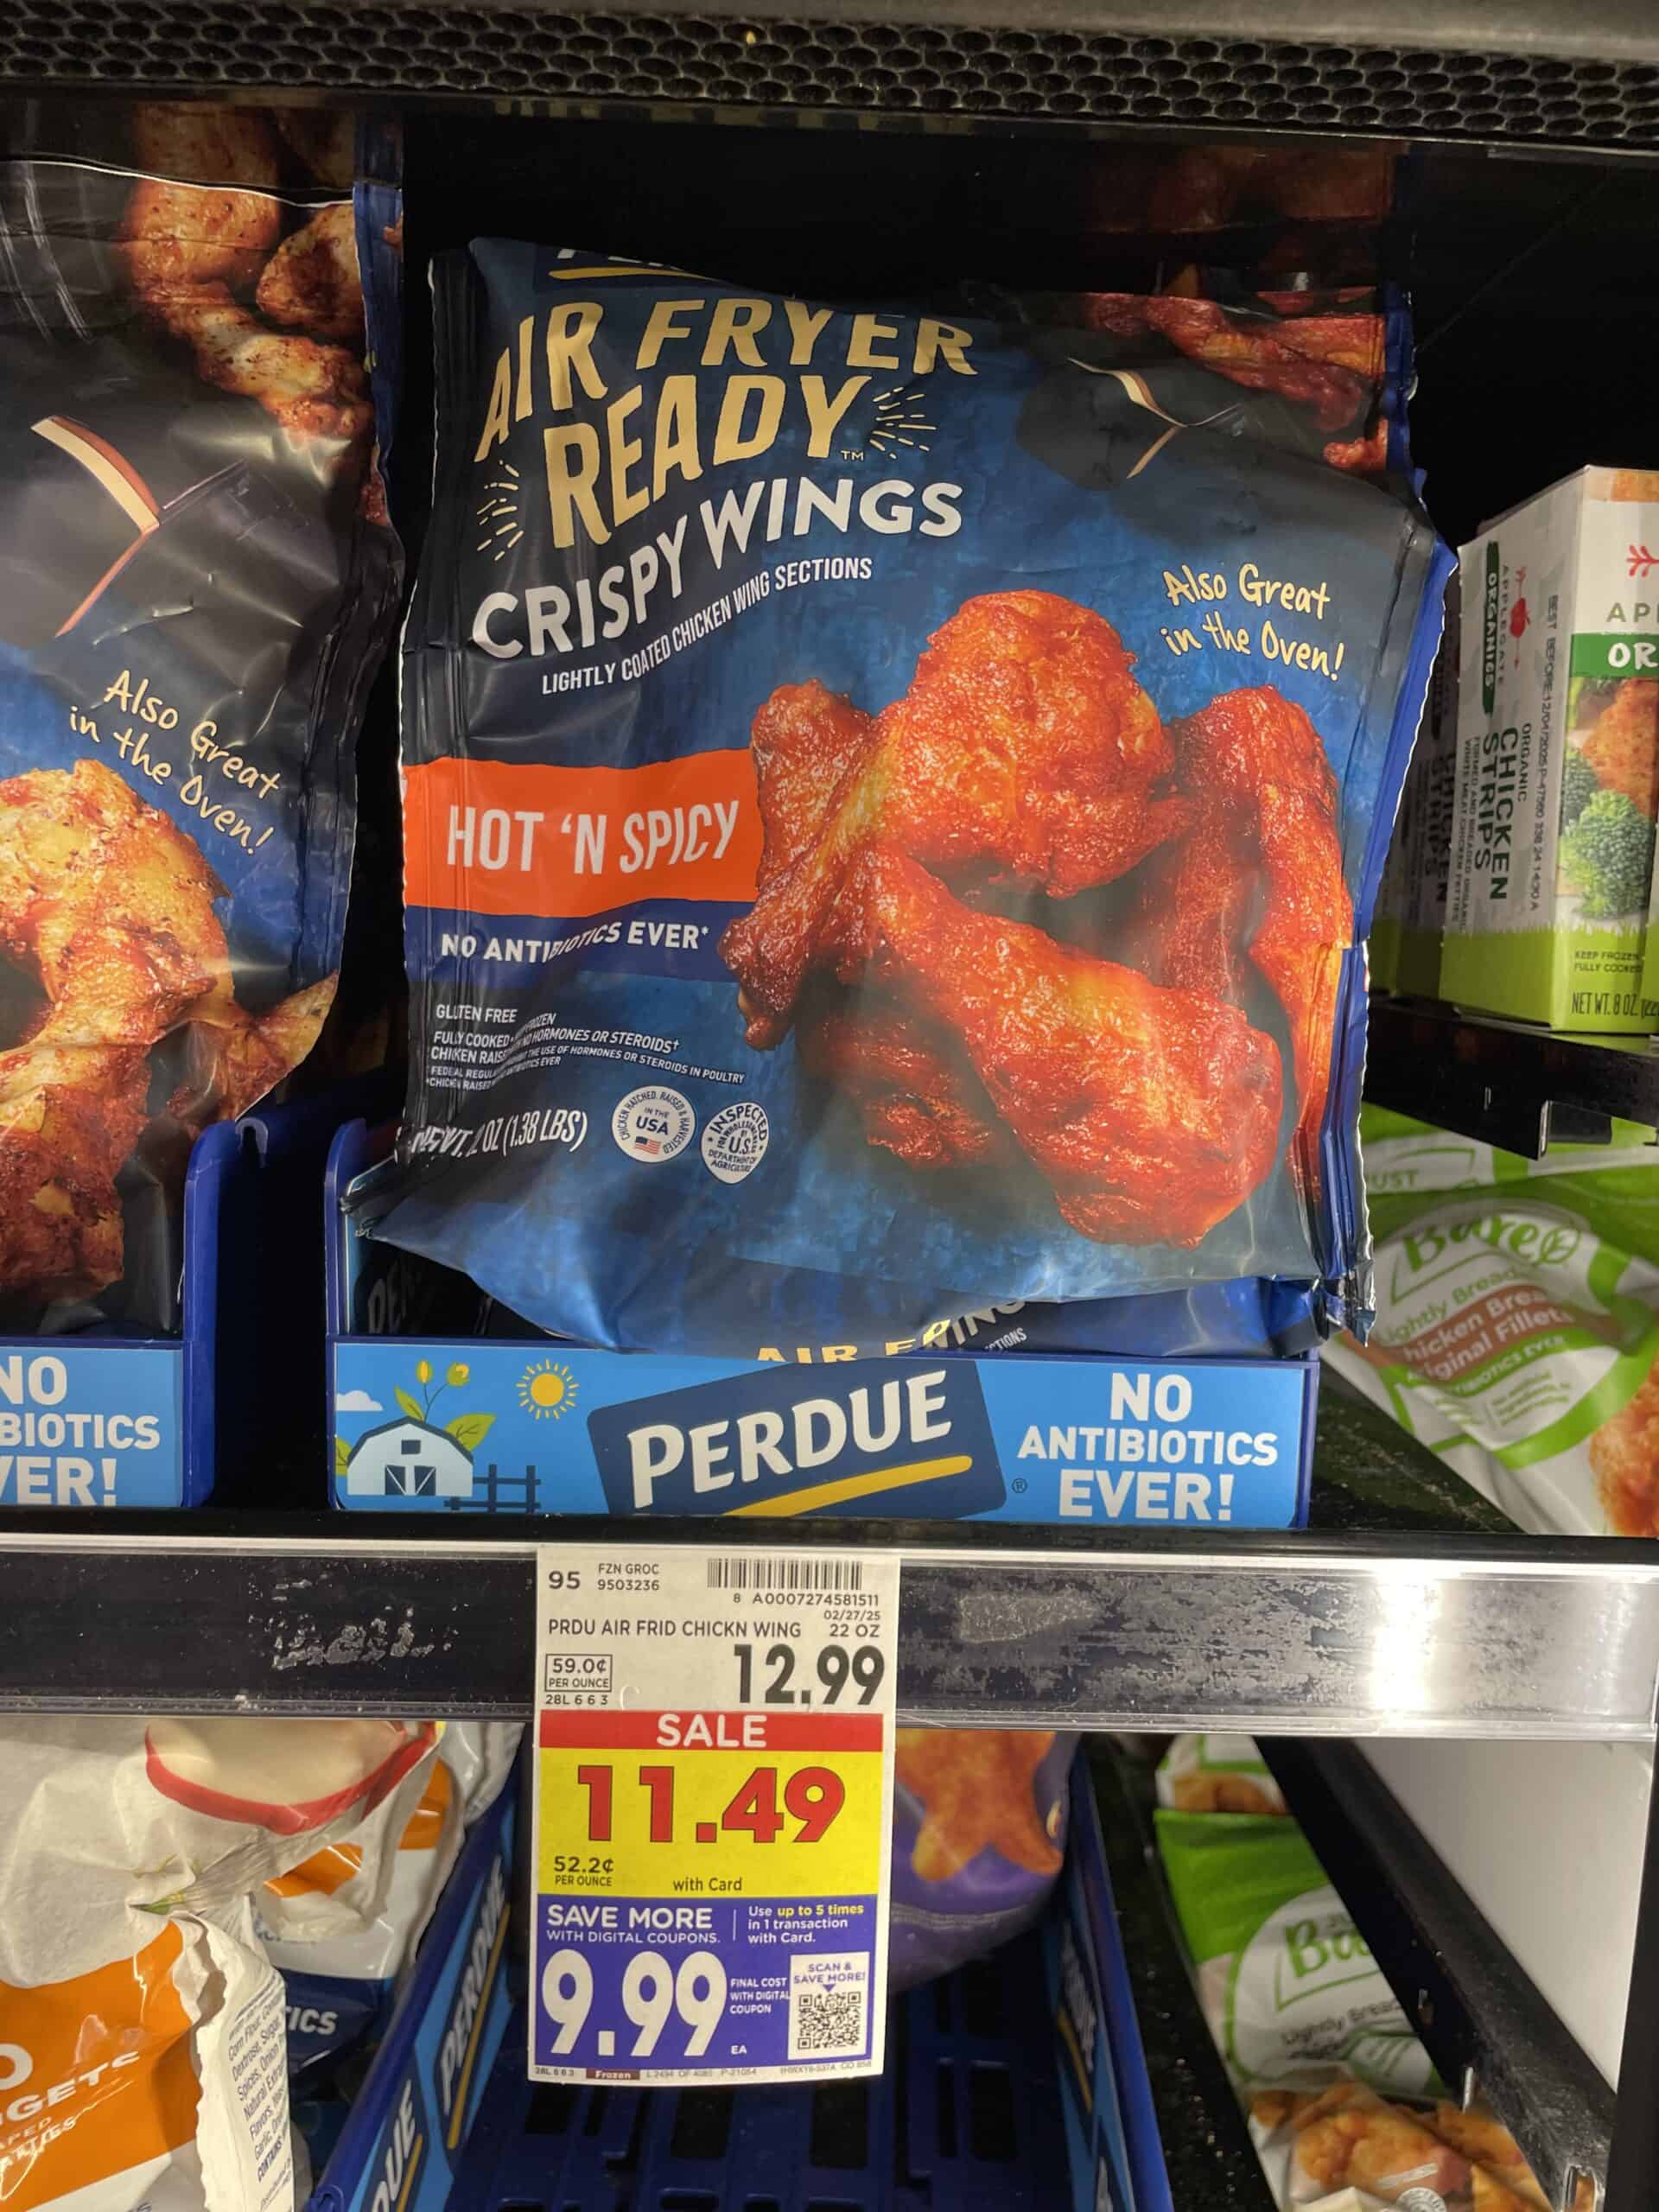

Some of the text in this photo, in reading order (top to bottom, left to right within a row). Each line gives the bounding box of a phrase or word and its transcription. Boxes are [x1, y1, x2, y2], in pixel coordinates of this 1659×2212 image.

[474, 298, 979, 463] AIR FRYER
[543, 374, 872, 550] READY
[472, 478, 963, 659] CRISPY WINGS
[1162, 563, 1332, 620] Also Great
[1605, 601, 1659, 623] AP
[542, 557, 873, 696] LIGHTLY COATED CHICKEN WING SECTIONS
[1485, 572, 1498, 688] ORGANICS
[1160, 610, 1345, 682] in the Oven!
[103, 669, 281, 799] Also Great
[1516, 722, 1532, 803] ORGANIC
[69, 705, 274, 855] in the Oven!
[1475, 734, 1498, 870] STRIPS
[1490, 728, 1518, 899] CHICKEN
[447, 804, 543, 872] HOT
[619, 799, 740, 874] SPICY
[441, 933, 476, 958] NO
[482, 920, 622, 964] ANTIBIOTICS
[1572, 992, 1592, 1015] NET
[485, 1008, 518, 1023] FREE
[532, 1028, 590, 1043] HORMONES
[592, 1030, 607, 1042] OR
[540, 1056, 562, 1066] EVER
[541, 1046, 556, 1055] USE
[557, 1046, 568, 1054] OF
[570, 1046, 622, 1059] HORMONES
[624, 1052, 637, 1062] OR
[639, 1055, 689, 1074] STEROIDS
[690, 1066, 700, 1077] IN
[702, 1068, 746, 1084] POULTRY
[617, 1109, 631, 1141] CHICKEN
[660, 1091, 684, 1111] RAISED
[655, 1109, 670, 1118] THE
[709, 1105, 768, 1141] INSPECTED
[482, 1118, 505, 1153] OZ
[502, 1110, 541, 1157] (1.38
[539, 1109, 588, 1153] LBS)
[636, 1116, 669, 1135] USA
[1402, 1312, 1484, 1363] hicken
[1109, 1372, 1192, 1423] NO
[626, 1369, 952, 1510] PERDUE
[1017, 1426, 1279, 1467] ANTIBIOTICS
[1058, 1469, 1234, 1522] EVER!
[598, 1562, 659, 1575] FZN GROC
[548, 1571, 582, 1590] 95
[597, 1579, 660, 1592] 9503236
[733, 1593, 880, 1607] 8 A0007274581511
[823, 1610, 880, 1622] 02/27/25
[549, 1618, 802, 1638] PRDU AIR FRID CHICKN WING
[829, 1624, 880, 1638] 22 OZ
[552, 1657, 607, 1675] 59.0¢
[733, 1643, 886, 1707] 12.99
[549, 1678, 609, 1688] PER OUNCE
[545, 1694, 571, 1706] 28L
[574, 1694, 584, 1706] 6
[587, 1694, 597, 1706] 6
[656, 1713, 768, 1748] SALE
[577, 1764, 846, 1844] 11.49
[553, 1855, 614, 1874] 52.2¢
[555, 1875, 613, 1887] PER OUNCE
[672, 1877, 742, 1892] with Card
[546, 1904, 713, 1929] SAVE MORE
[747, 1917, 849, 1930] in 1 transaction
[748, 1904, 864, 1920] Use up to 5 times
[546, 1930, 721, 1944] WITH DIGITAL COUPONS.
[747, 1931, 816, 1943] with Card.
[793, 1973, 823, 1985] SAVE
[807, 1961, 853, 1974] SCAN &
[440, 1854, 505, 2116] PERDUE
[730, 1977, 789, 1988] FINAL COST
[541, 1948, 728, 2057] 9.99
[729, 1990, 791, 2001] WITH DIGITAL
[729, 2004, 772, 2015] COUPON
[731, 2044, 747, 2055] EA
